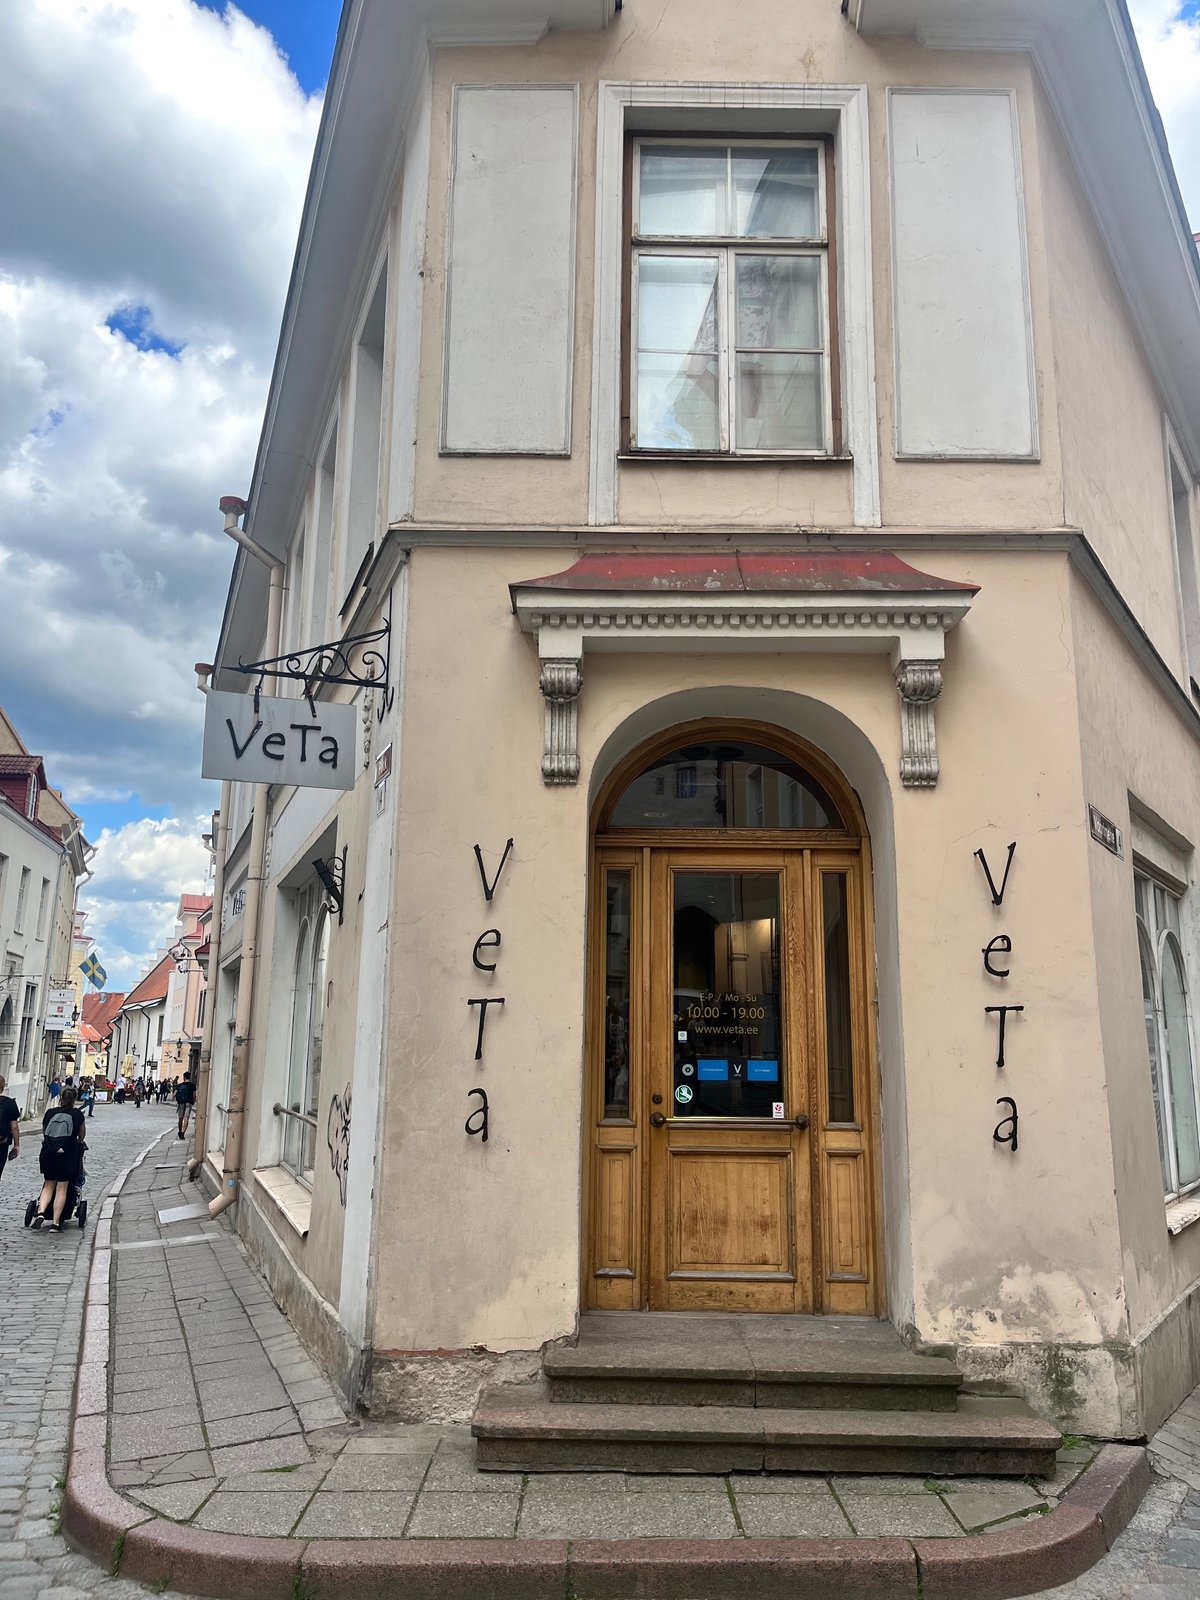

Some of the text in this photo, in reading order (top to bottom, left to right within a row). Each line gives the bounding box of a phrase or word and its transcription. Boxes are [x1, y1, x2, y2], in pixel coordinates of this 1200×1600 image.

[221, 718, 339, 769] VeTa
[700, 993, 714, 1002] E-P
[725, 993, 739, 1002] Mo
[746, 993, 757, 1002] Su
[687, 1006, 720, 1018] 10.00
[732, 1007, 765, 1019] 19.00
[695, 1025, 759, 1035] www.veta.ee
